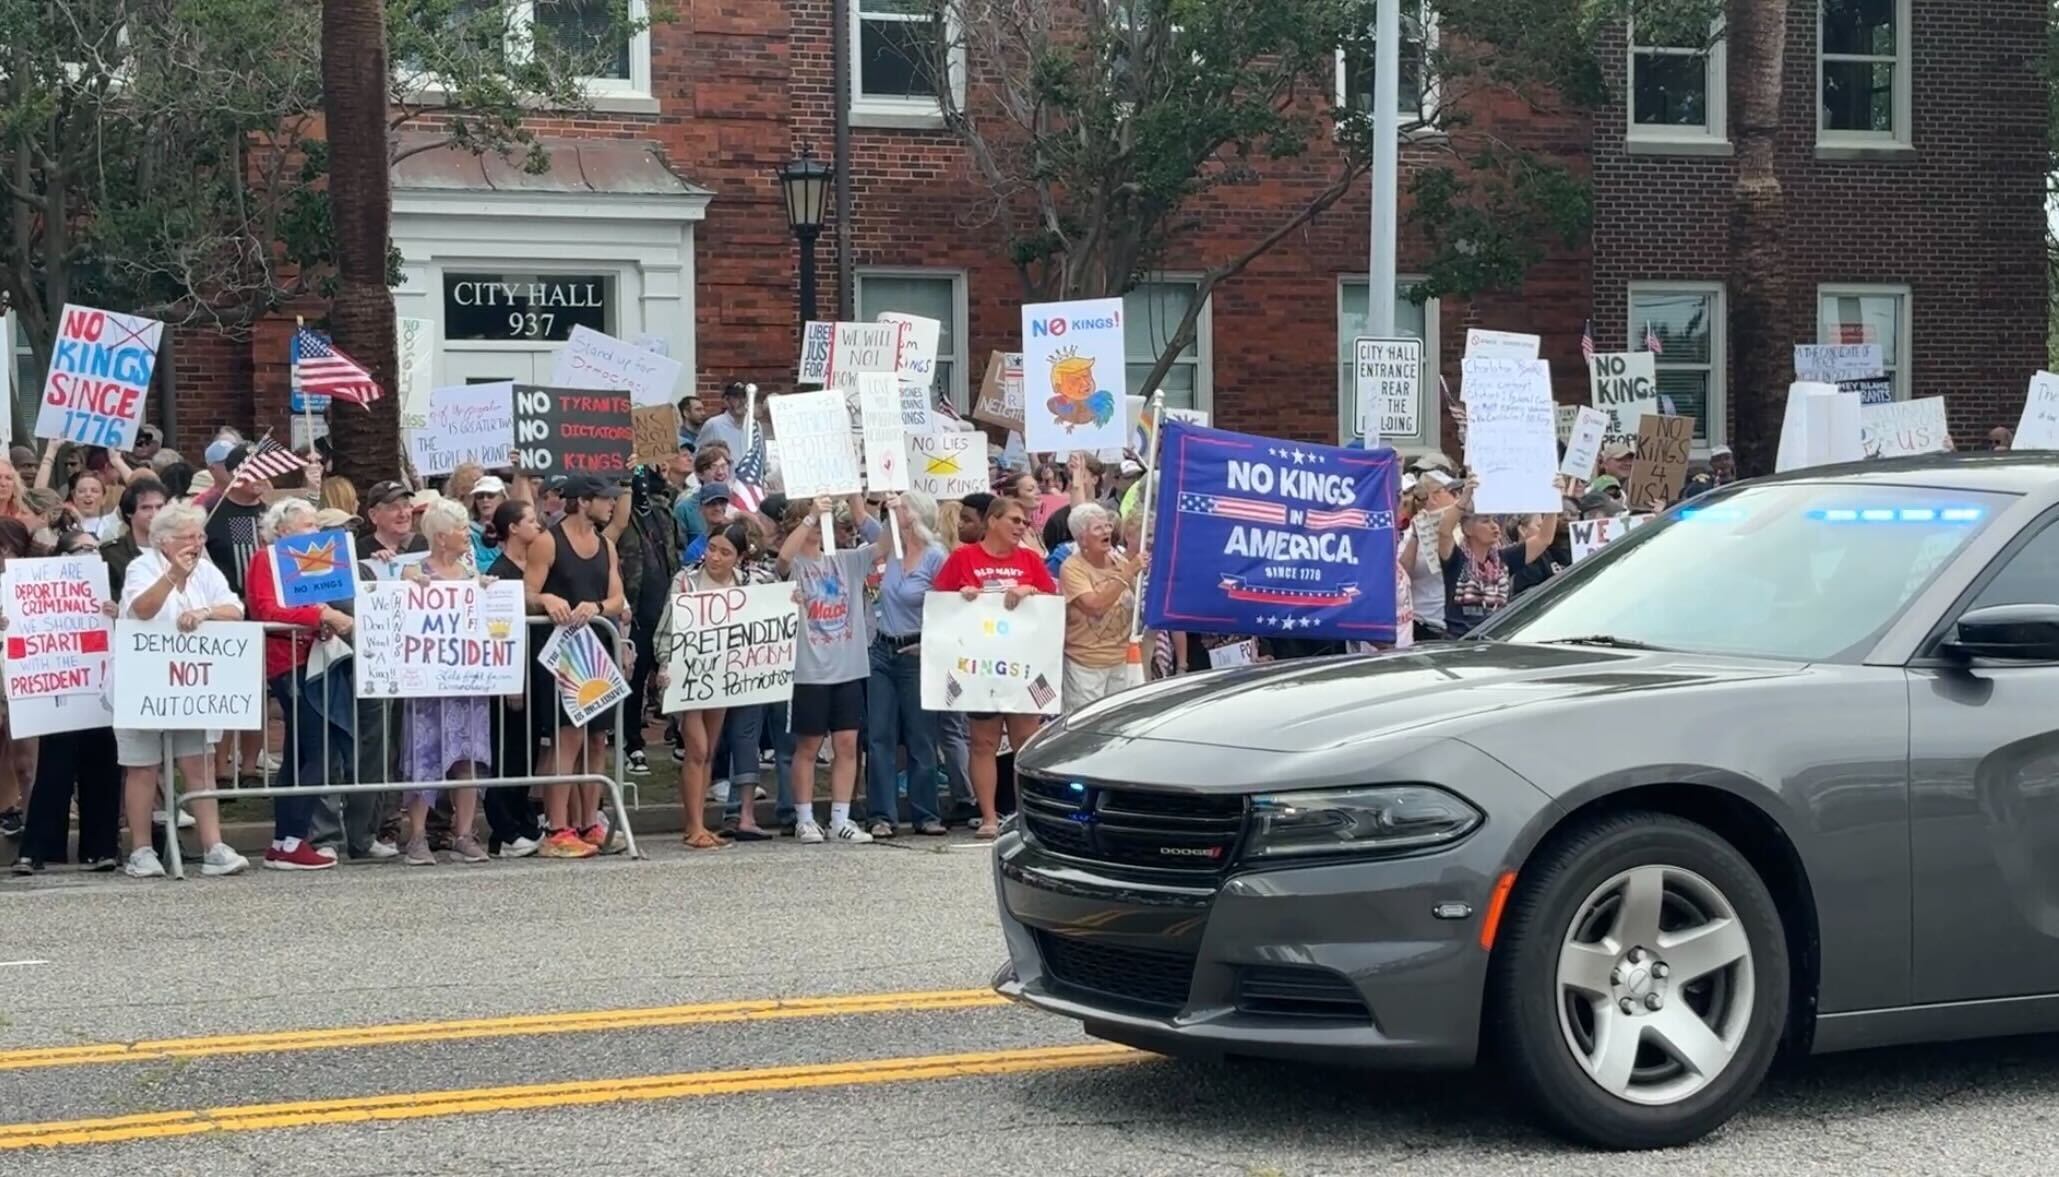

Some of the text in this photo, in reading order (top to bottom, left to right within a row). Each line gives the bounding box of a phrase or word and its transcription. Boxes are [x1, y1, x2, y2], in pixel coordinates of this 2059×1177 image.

[453, 281, 603, 308] CITY HALL
[64, 310, 105, 342] NO
[508, 312, 555, 337] 937
[1032, 310, 1120, 337] NO KINGS!
[864, 329, 890, 347] WILL
[54, 339, 155, 386] KINGS
[849, 350, 879, 366] NOT
[1360, 345, 1416, 361] CITY HALL
[803, 362, 824, 377] FOR
[1360, 362, 1416, 379] ENTRANCE
[1595, 356, 1626, 377] NO
[47, 372, 140, 419] SINCE
[1381, 381, 1410, 397] REAR
[517, 391, 631, 414] NO TYRANTS
[1388, 398, 1408, 414] THE
[60, 410, 126, 448] 1776
[518, 419, 550, 440] NO
[1361, 415, 1413, 432] LDING
[1655, 417, 1684, 440] NO
[417, 435, 439, 452] THE
[912, 436, 969, 451] NO LIES
[520, 448, 624, 470] NO KINGS
[1227, 459, 1357, 506] NO KINGS
[1649, 466, 1667, 482] 4
[914, 477, 985, 495] NO KINGS
[1630, 483, 1671, 507] USA
[1289, 509, 1304, 526] IN
[1571, 519, 1610, 545] WE
[1223, 525, 1360, 566] AMERICA.
[32, 564, 49, 581] WE
[59, 562, 83, 580] ARE
[974, 567, 1025, 577] OLD NAVY
[1264, 566, 1297, 580] SINCE
[15, 581, 92, 600] DEPORTING
[294, 579, 344, 594] NO KINGS
[22, 598, 101, 616] CRIMINALS
[407, 586, 459, 611] NOT
[675, 588, 747, 631] STOP
[43, 616, 100, 632] SHOULD
[421, 612, 461, 635] MY
[983, 619, 1010, 635] NO
[25, 632, 81, 656] START
[132, 632, 249, 658] DEMOCRACY
[667, 612, 798, 663] PRETENDING
[375, 651, 387, 665] A
[403, 635, 516, 668] PRESIDENT
[725, 642, 792, 672] RACISM
[20, 655, 79, 671] WITH THE
[169, 661, 213, 687] NOT
[680, 673, 714, 703] IS
[140, 694, 252, 717] AUTOCRACY
[1160, 847, 1213, 857] DODGE
